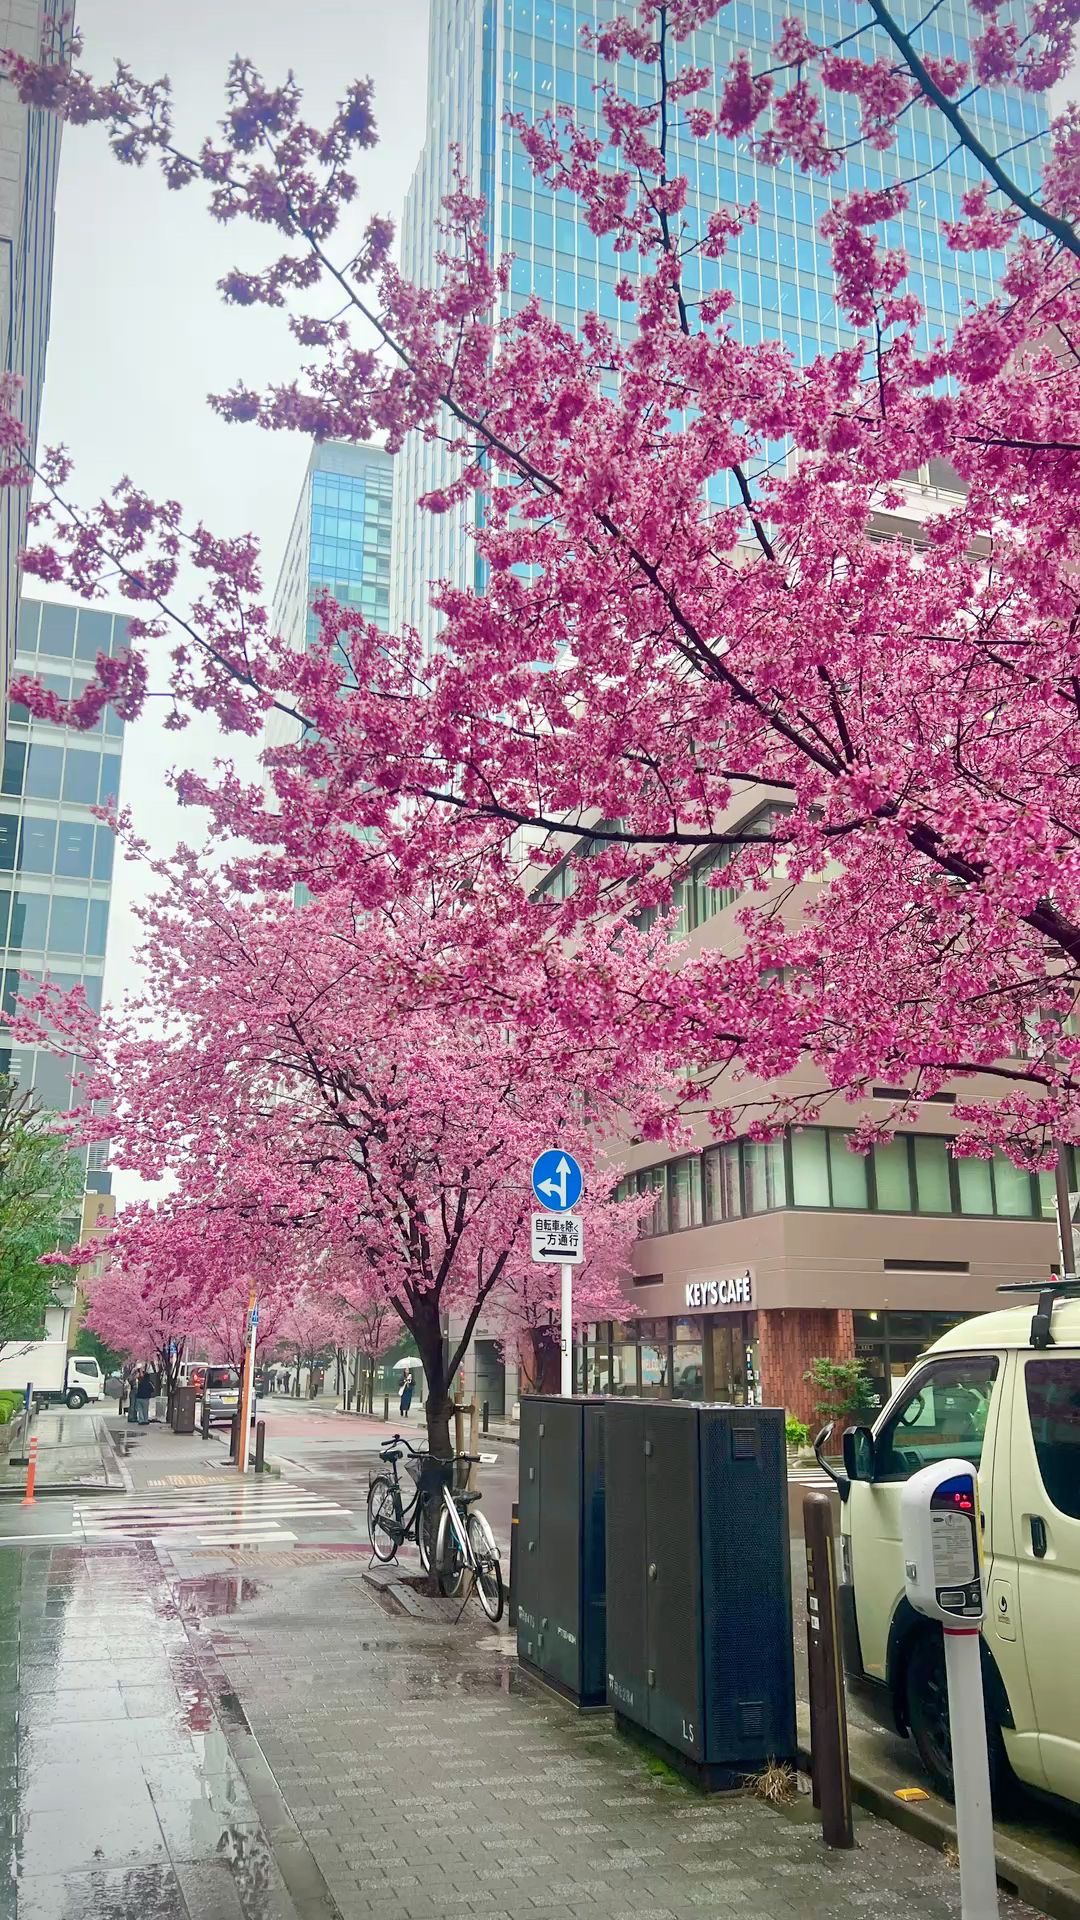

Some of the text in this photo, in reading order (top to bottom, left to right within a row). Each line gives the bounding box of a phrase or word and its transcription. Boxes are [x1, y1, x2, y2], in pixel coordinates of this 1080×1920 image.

[535, 1219, 579, 1232] 自転車を除く
[535, 1234, 579, 1247] 一方通行
[685, 1269, 752, 1308] KEY'S CAFÉ
[682, 1719, 694, 1743] LS
